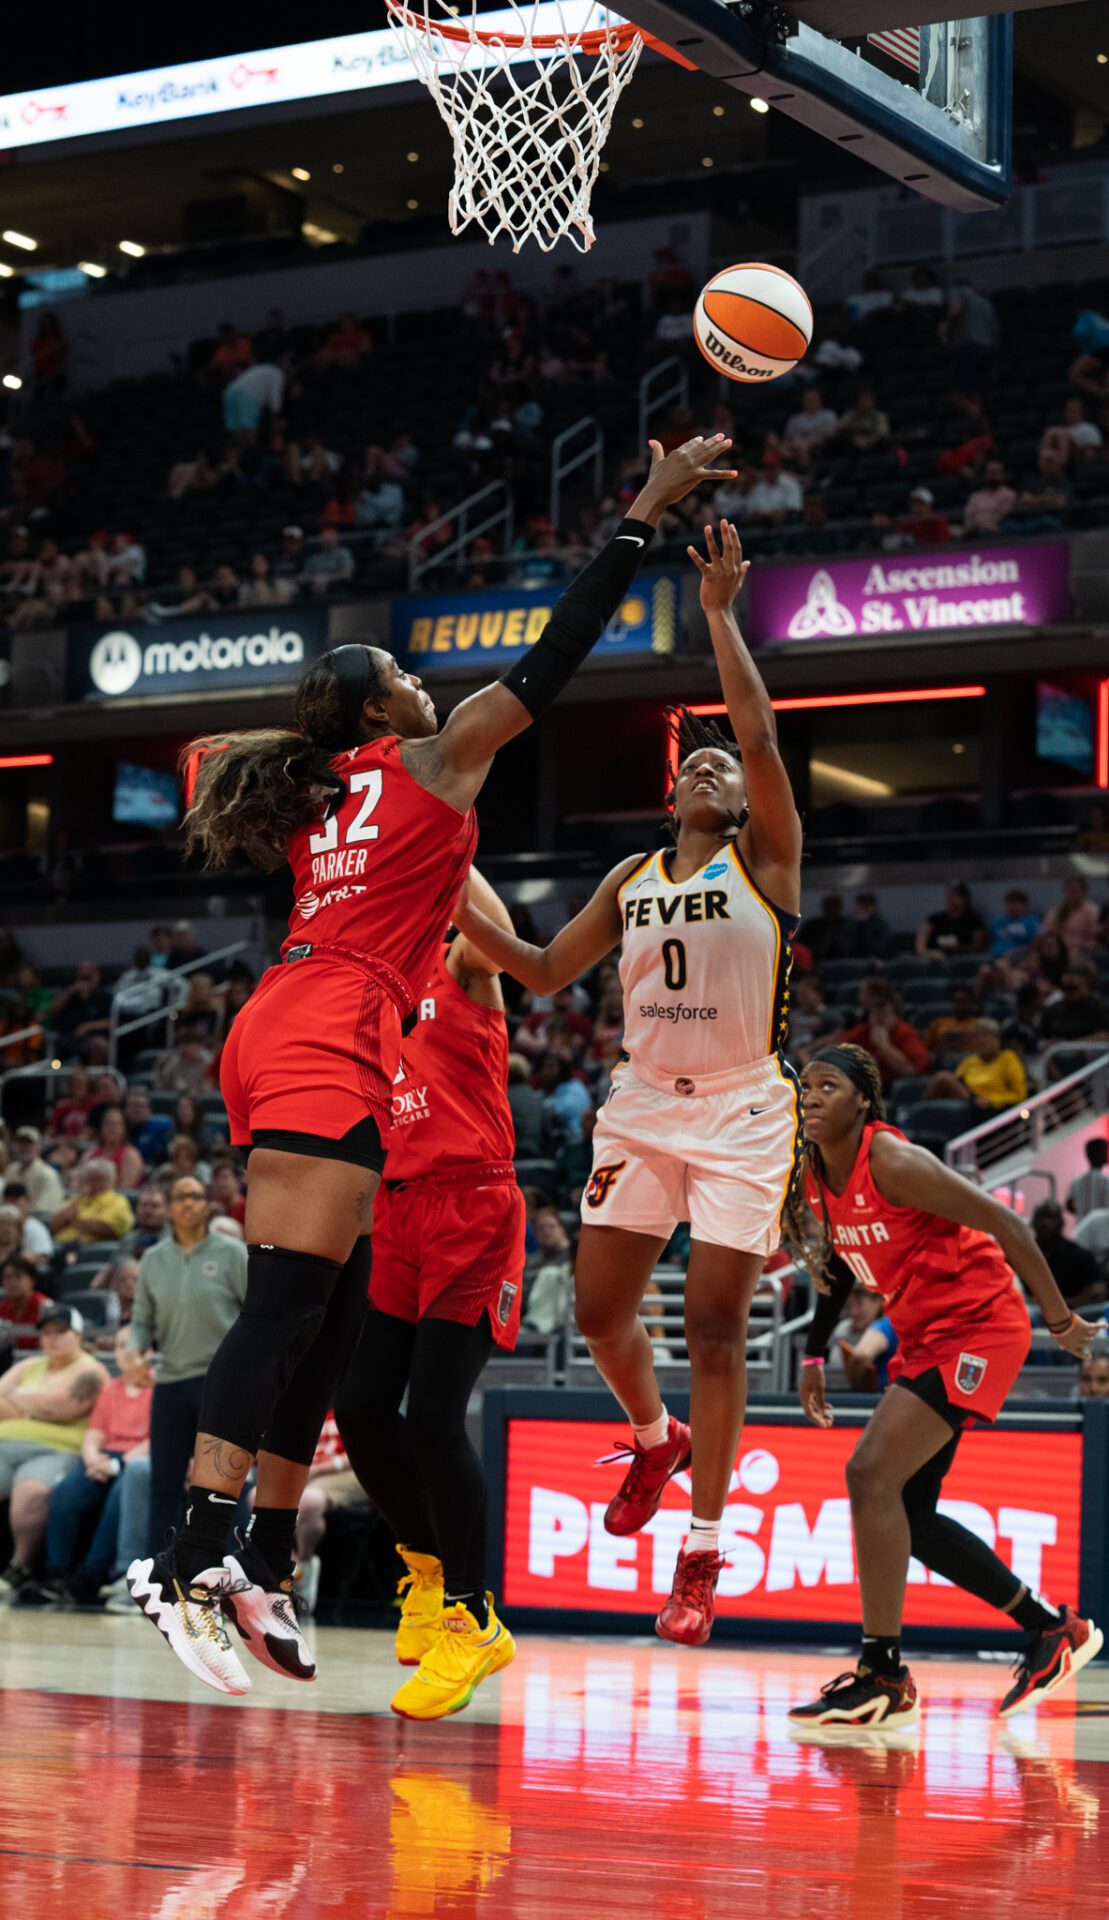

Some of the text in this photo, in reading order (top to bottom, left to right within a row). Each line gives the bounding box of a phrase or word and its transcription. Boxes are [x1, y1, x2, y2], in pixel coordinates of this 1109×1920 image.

[115, 78, 219, 112] KeyBank
[705, 330, 775, 378] Wilson
[863, 555, 1019, 595] Ascension
[861, 592, 1025, 633] St. Vincent
[143, 625, 304, 677] motorola
[311, 848, 368, 885] PARKER
[319, 885, 368, 908] AT&T
[625, 889, 731, 931] FEVER
[662, 938, 687, 991] 0
[640, 1002, 718, 1024] salesforce
[390, 1086, 428, 1116] ORY
[840, 1251, 878, 1287] 10
[528, 1486, 1057, 1600] PETSMT
